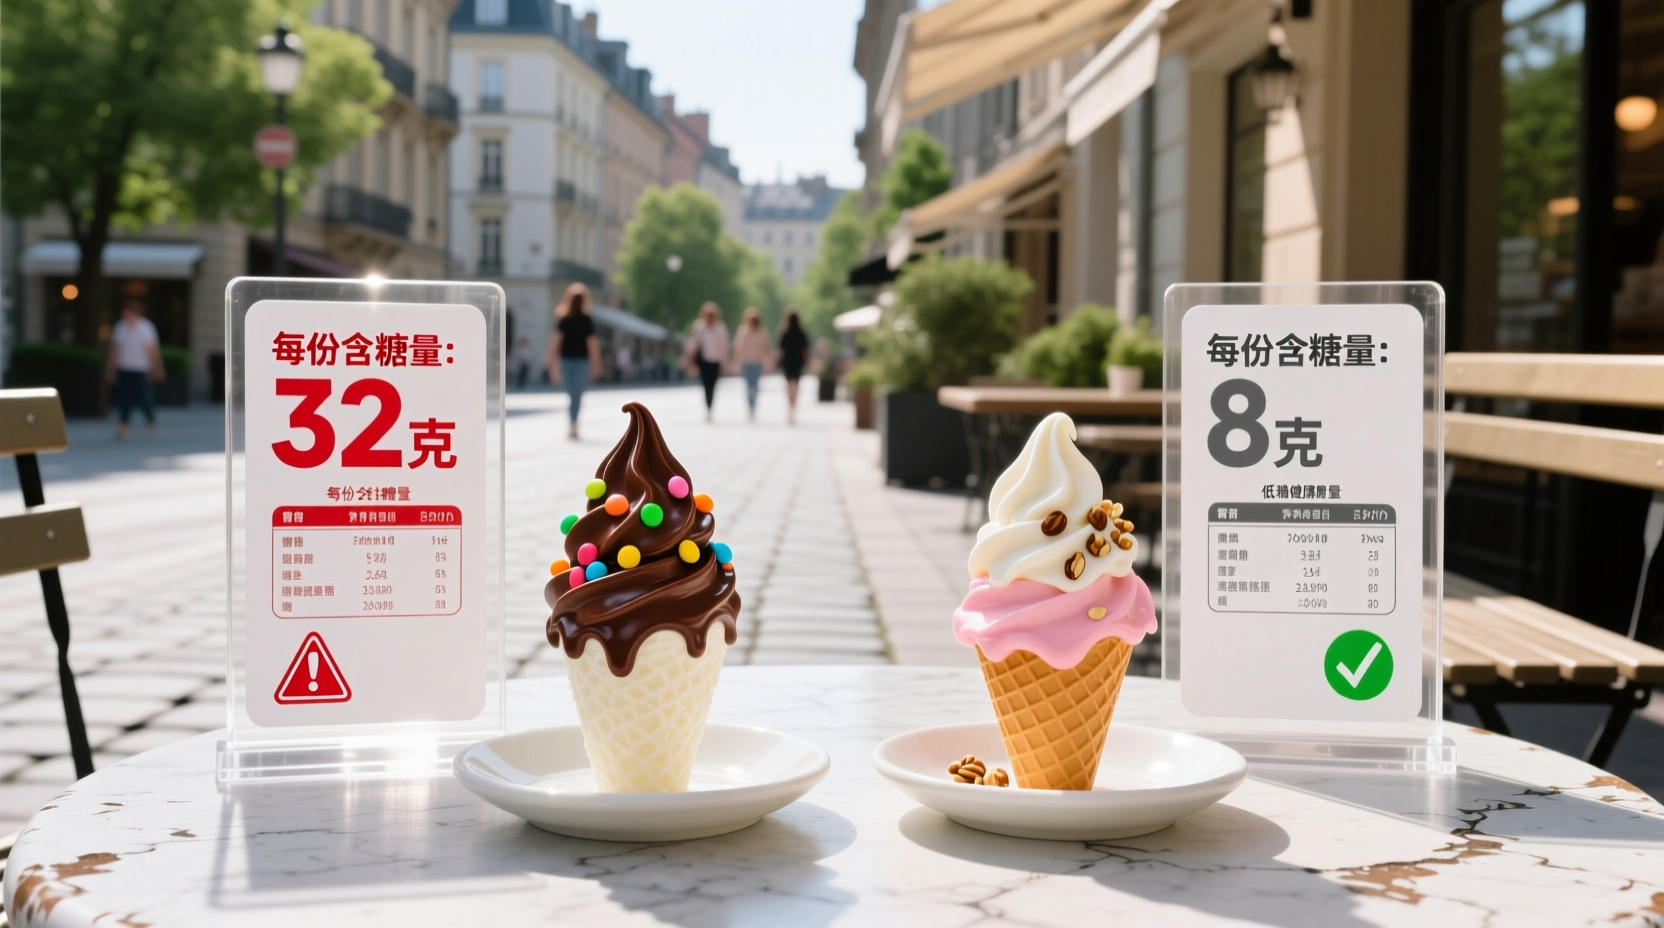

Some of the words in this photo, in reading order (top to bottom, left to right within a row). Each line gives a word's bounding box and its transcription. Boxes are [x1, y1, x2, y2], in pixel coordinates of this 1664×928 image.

[272, 331, 454, 367] 每份含糖量:
[1206, 332, 1388, 367] 每份含糖量:
